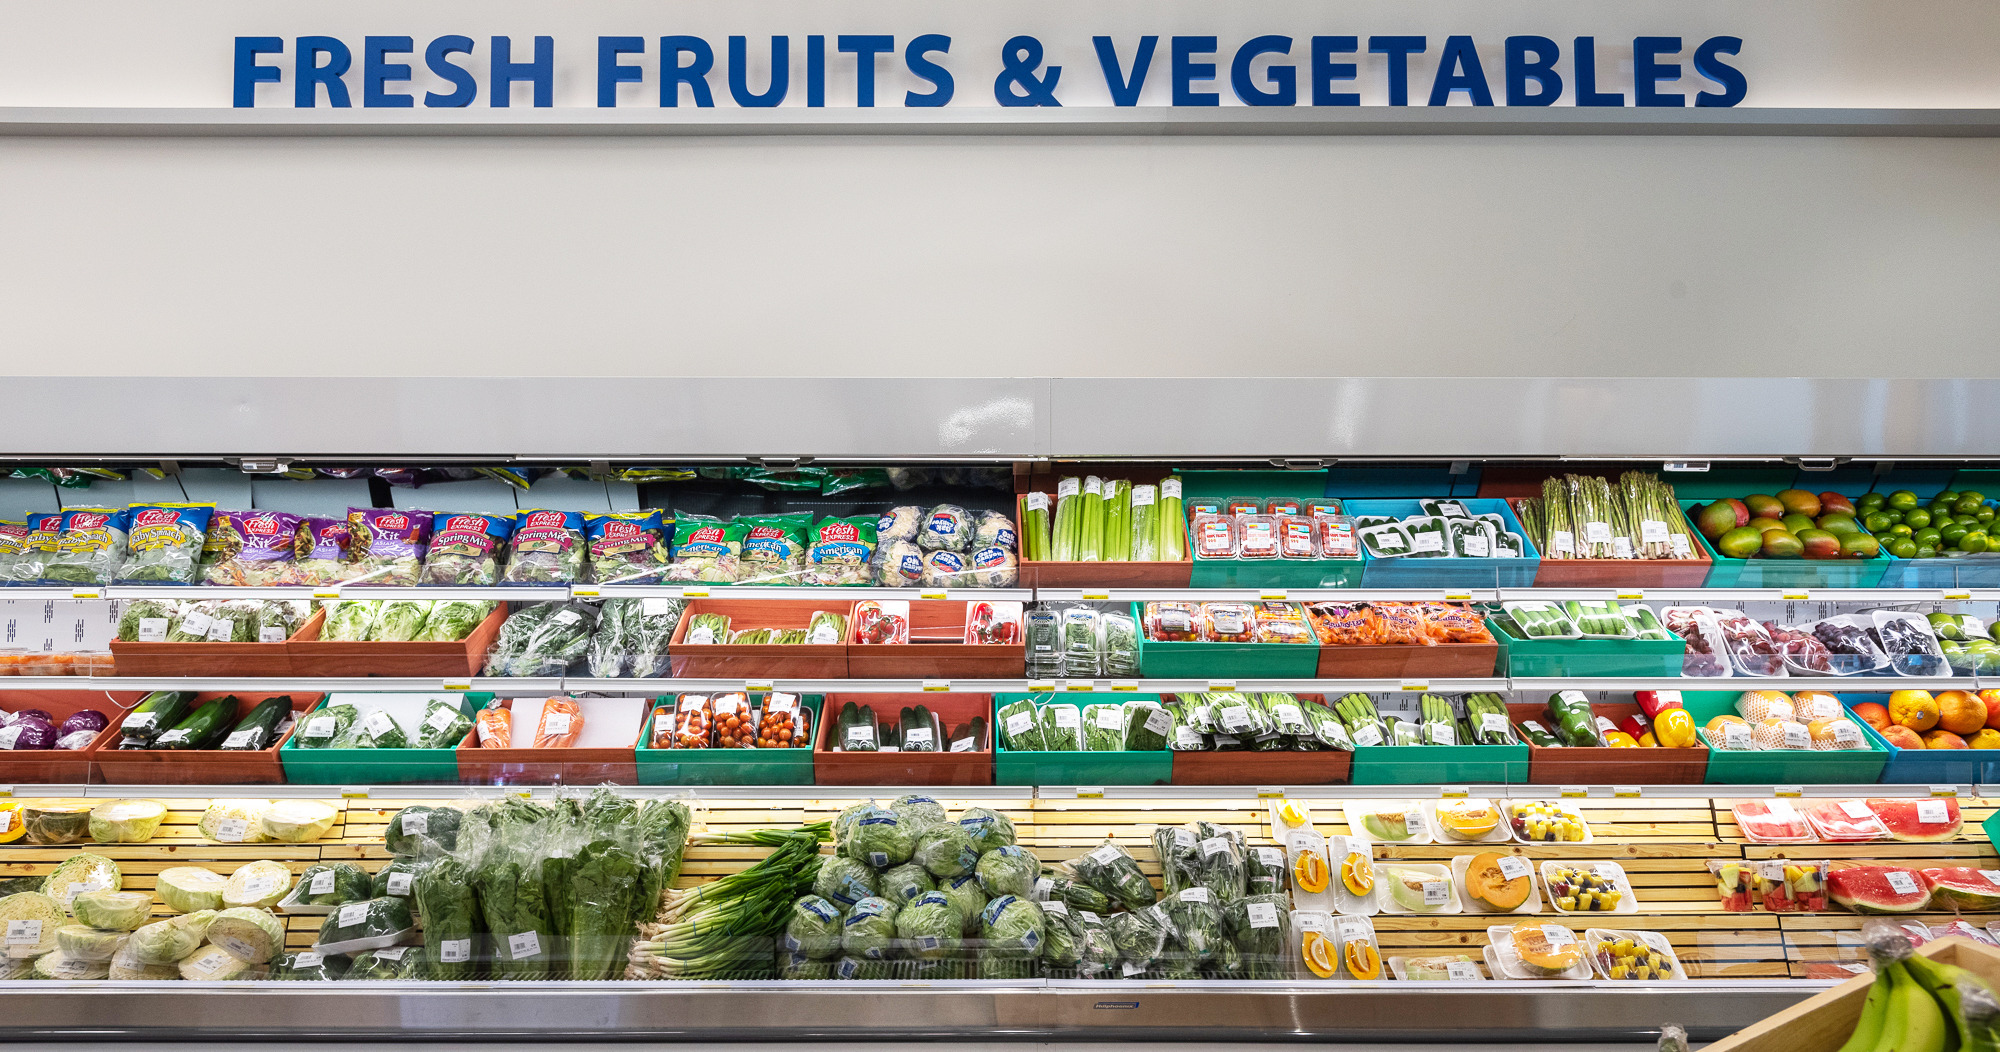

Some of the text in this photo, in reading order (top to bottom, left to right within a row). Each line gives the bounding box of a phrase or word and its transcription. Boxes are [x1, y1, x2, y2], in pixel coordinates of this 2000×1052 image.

[233, 34, 1748, 107] FRESH FRUITS & VEGETABLES
[142, 510, 176, 520] Fresh
[380, 515, 405, 524] Fresh
[532, 512, 562, 522] Fresh
[249, 520, 276, 529] Fresh
[453, 516, 484, 526] Fresh
[450, 524, 483, 532] EXPRESS
[609, 522, 637, 534] Fresh
[825, 525, 855, 535] Fresh
[150, 528, 181, 542] Spinach
[377, 529, 400, 541] Kit
[438, 532, 488, 548] Spring Mix
[517, 530, 549, 543] Spring
[319, 537, 336, 547] Ki
[630, 536, 649, 546] Mix
[820, 543, 864, 556] American
[978, 548, 993, 558] Oak
